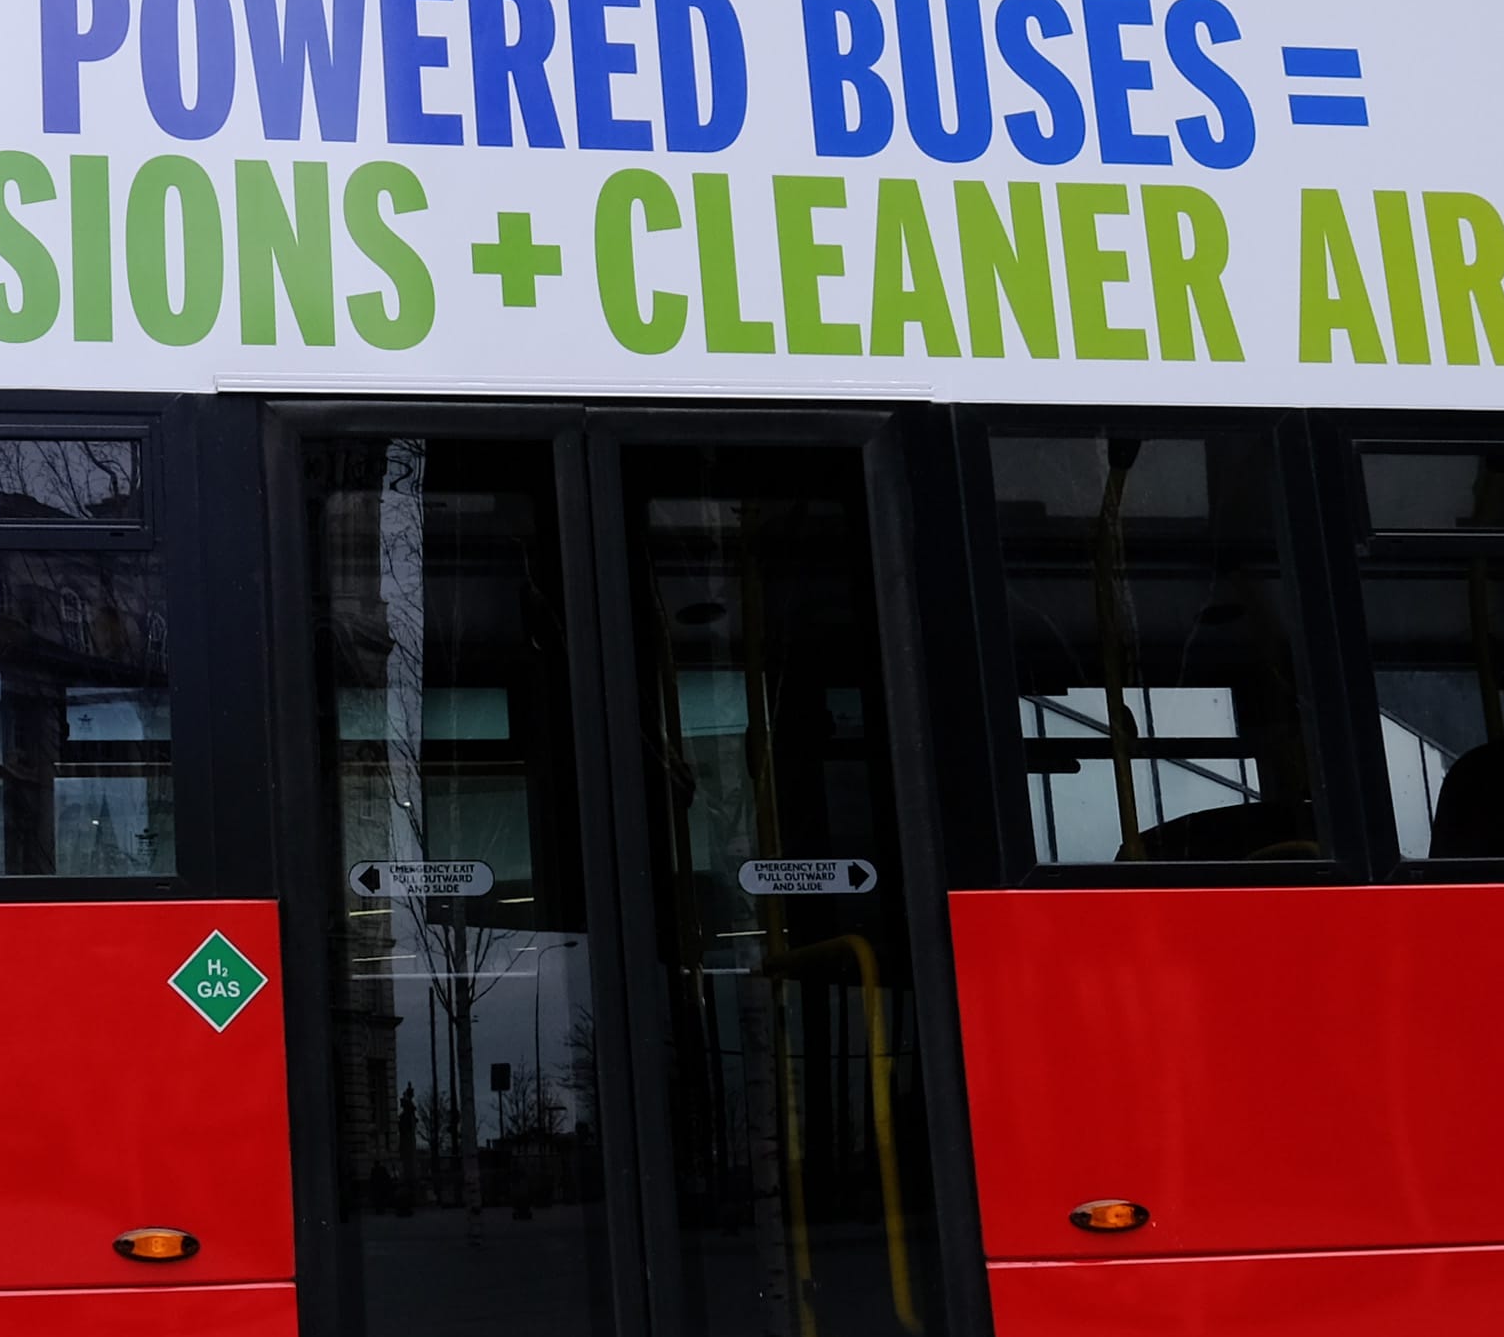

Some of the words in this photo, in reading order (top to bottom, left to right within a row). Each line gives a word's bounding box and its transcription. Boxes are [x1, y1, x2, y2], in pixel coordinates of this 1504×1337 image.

[1280, 45, 1370, 128] =
[470, 210, 563, 309] +
[593, 166, 1246, 363] CLEANER
[390, 864, 451, 873] EMERGENCY
[453, 864, 475, 873] EXIT
[754, 863, 813, 872] EMERGENCY
[816, 862, 836, 871] EXIT
[393, 874, 416, 883] PULL
[420, 874, 473, 883] OUTWARD
[758, 873, 782, 882] PULL
[784, 872, 835, 881] OUTWARD
[408, 884, 430, 894] AND
[432, 884, 459, 893] SLIDE
[773, 882, 794, 892] AND
[797, 882, 822, 891] SLIDE
[197, 979, 241, 1000] GAS
